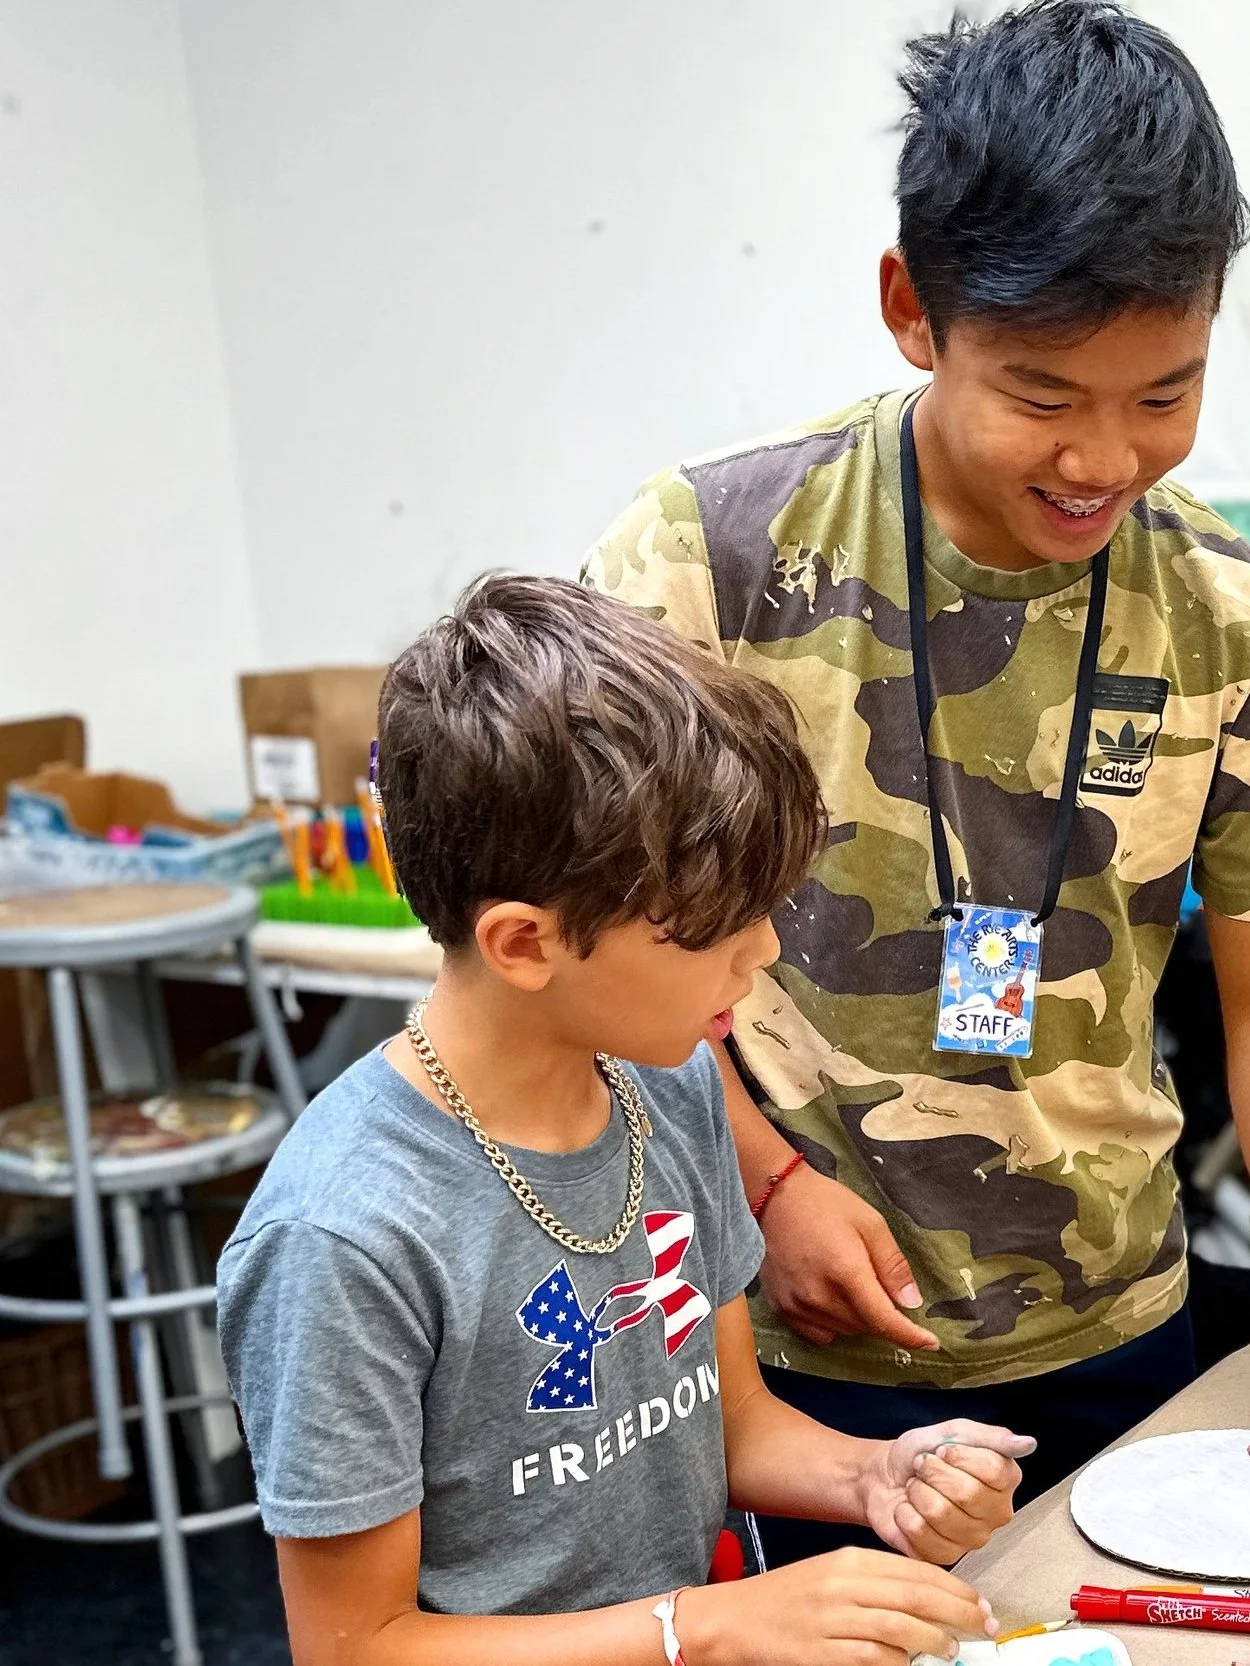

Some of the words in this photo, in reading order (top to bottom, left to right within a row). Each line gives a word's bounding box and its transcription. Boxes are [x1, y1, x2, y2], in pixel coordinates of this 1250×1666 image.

[967, 930, 982, 955] THE
[980, 923, 1001, 936] RYE
[1001, 928, 1018, 957] ARTS
[970, 957, 1014, 977] CENTER
[955, 1013, 1014, 1036] STAFF
[1147, 1602, 1202, 1623] SKETCH
